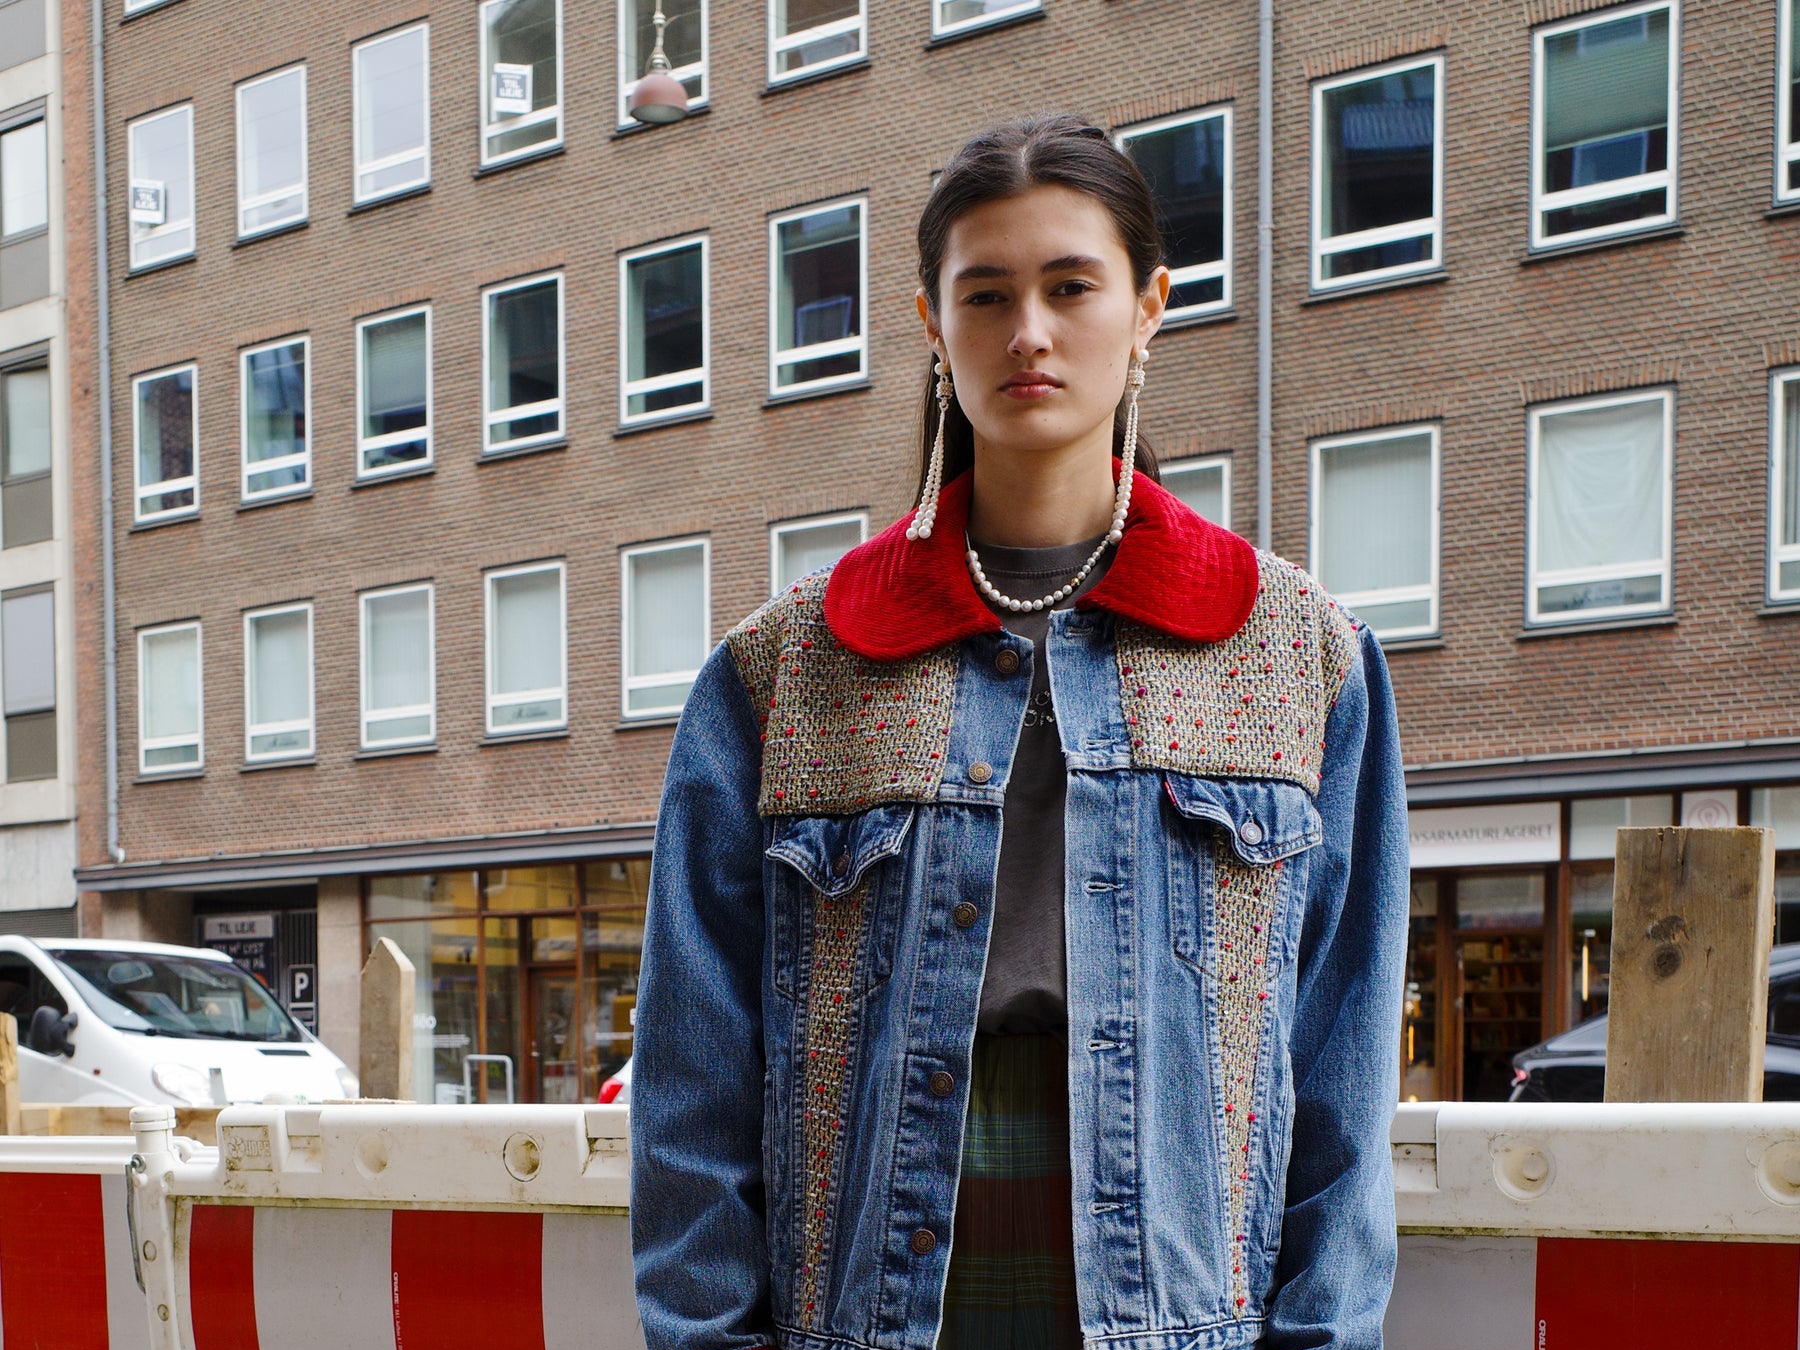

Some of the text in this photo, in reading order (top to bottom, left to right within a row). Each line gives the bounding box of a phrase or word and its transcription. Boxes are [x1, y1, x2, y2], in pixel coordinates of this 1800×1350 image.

[217, 921, 256, 934] TIL LEJE
[294, 972, 310, 999] P
